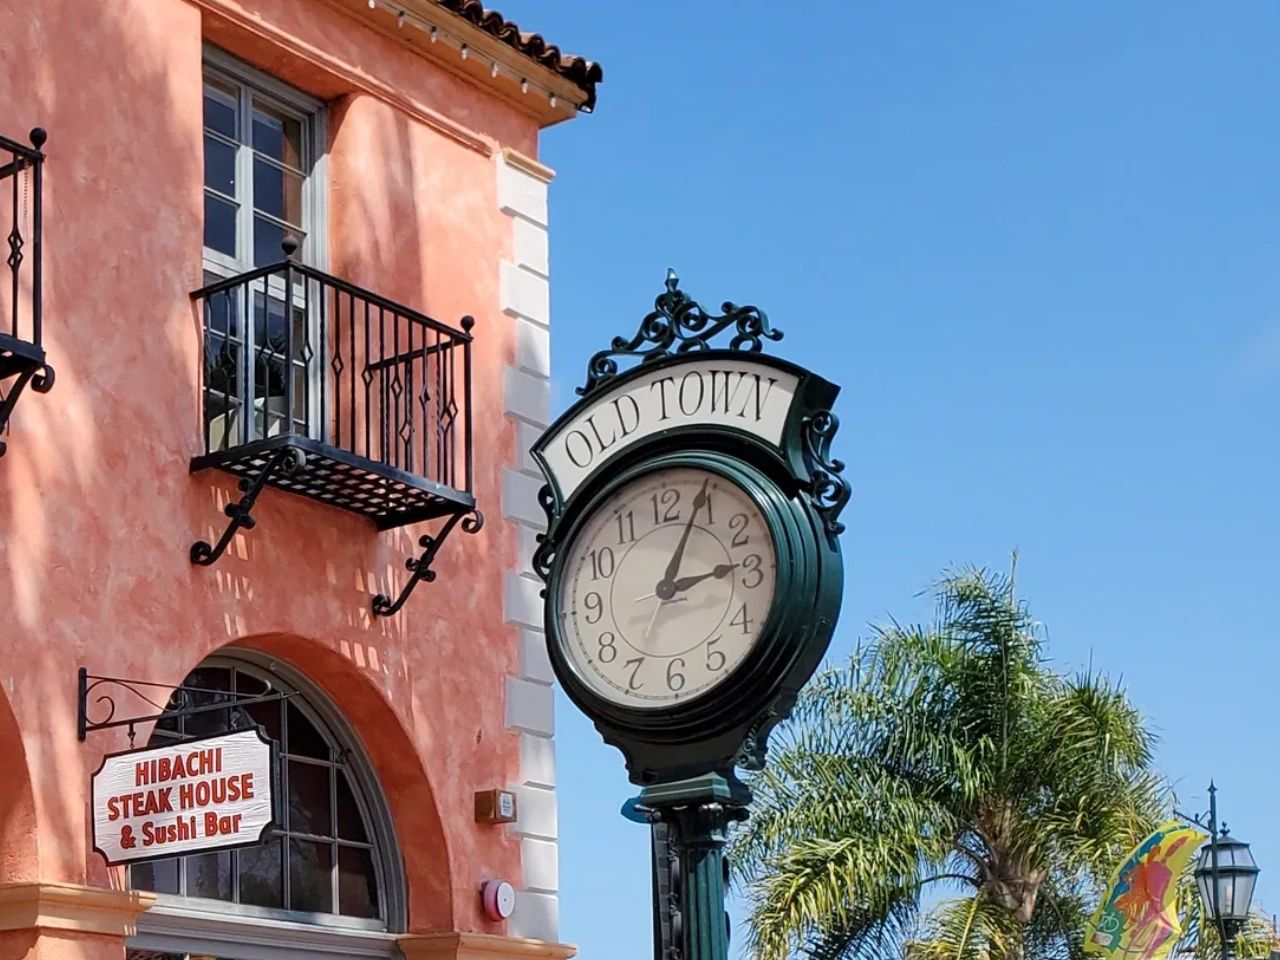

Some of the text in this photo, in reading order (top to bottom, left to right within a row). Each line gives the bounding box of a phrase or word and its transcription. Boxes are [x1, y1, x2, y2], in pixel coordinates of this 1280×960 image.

[564, 370, 778, 469] OLD TOWN
[650, 488, 681, 525] 12
[615, 510, 638, 545] 11
[728, 513, 750, 548] 2
[589, 546, 615, 581] 10
[741, 553, 764, 589] 3
[584, 592, 603, 624] 9
[729, 603, 754, 635] 4
[598, 631, 617, 663] 8
[705, 635, 726, 672] 5
[622, 657, 645, 690] 7
[665, 658, 686, 692] 6
[135, 747, 223, 787] HIBACHI
[107, 772, 255, 821] STEAK HOUSE
[120, 811, 242, 850] & Sushi Bar
